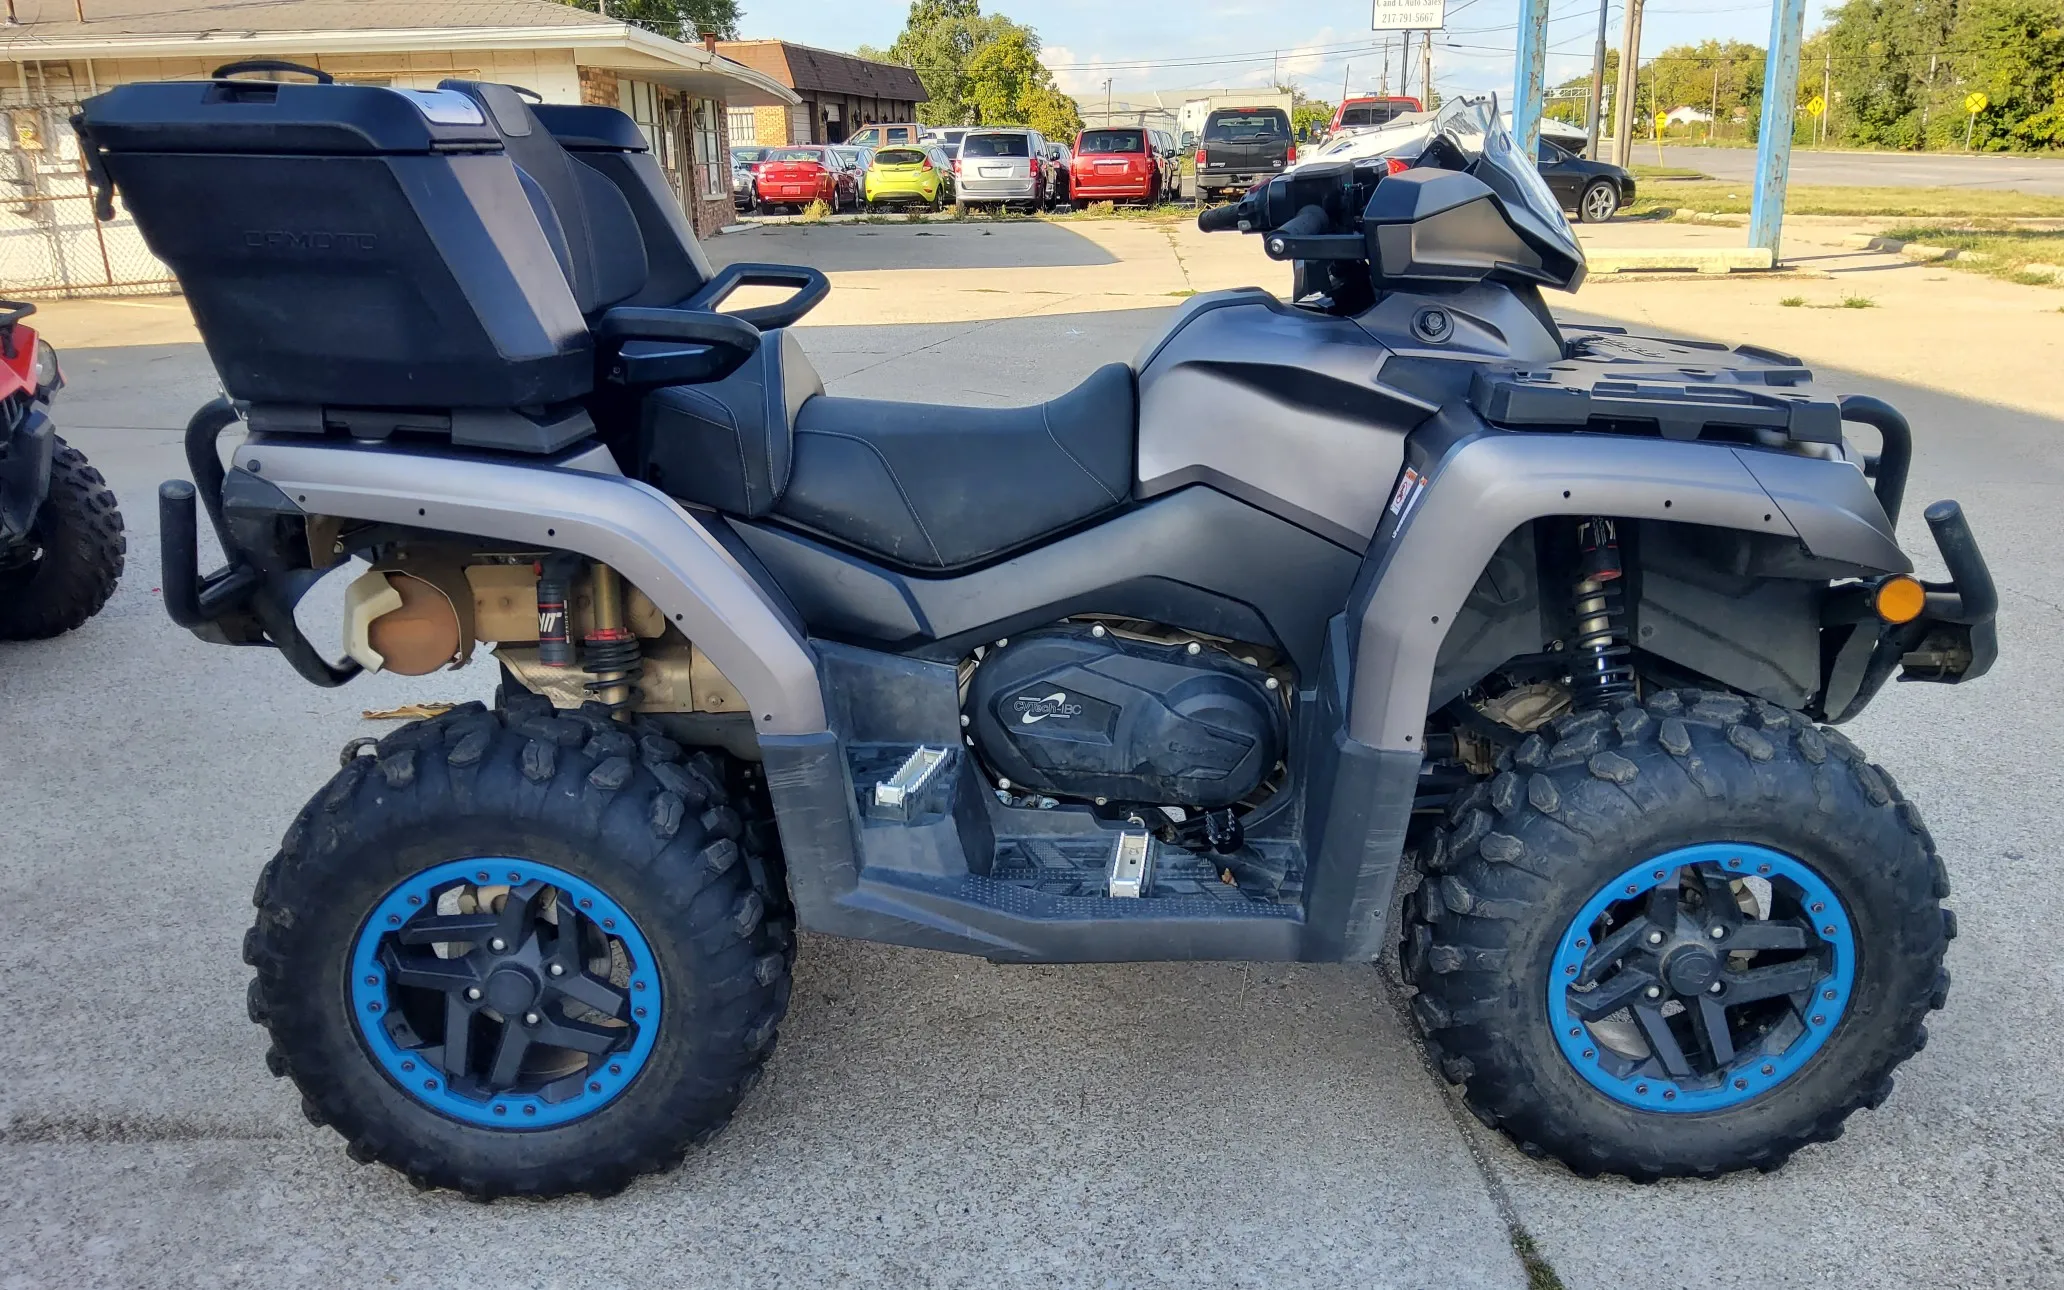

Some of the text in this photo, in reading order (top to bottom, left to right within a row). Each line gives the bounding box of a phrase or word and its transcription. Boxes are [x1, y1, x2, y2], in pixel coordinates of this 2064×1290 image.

[1382, 12, 1434, 24] 217-791-5667
[243, 229, 378, 250] CFMOTO
[1013, 700, 1082, 715] CVTech-IBC
